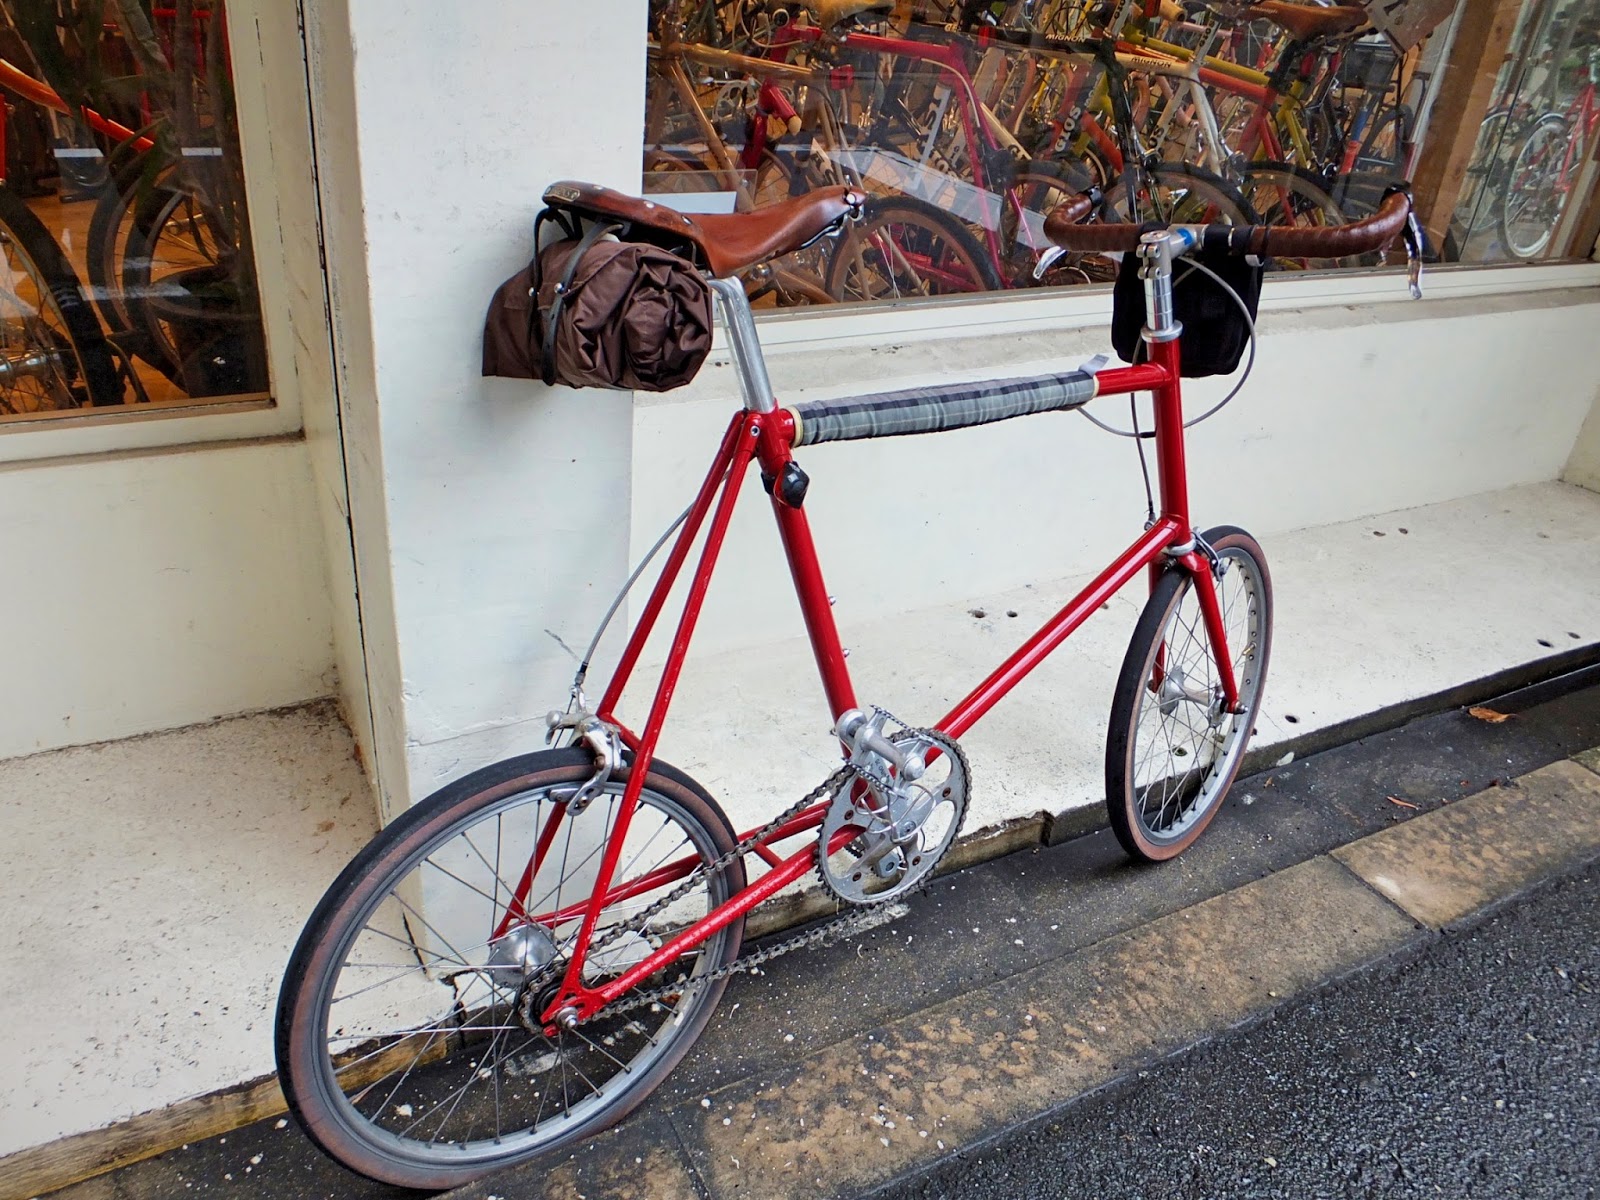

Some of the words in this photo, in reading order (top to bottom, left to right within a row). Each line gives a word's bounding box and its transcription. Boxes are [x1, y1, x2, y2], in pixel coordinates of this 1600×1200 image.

[1045, 33, 1086, 43] MIGNON
[1131, 56, 1171, 68] MIGNON
[1055, 106, 1081, 152] GIOS
